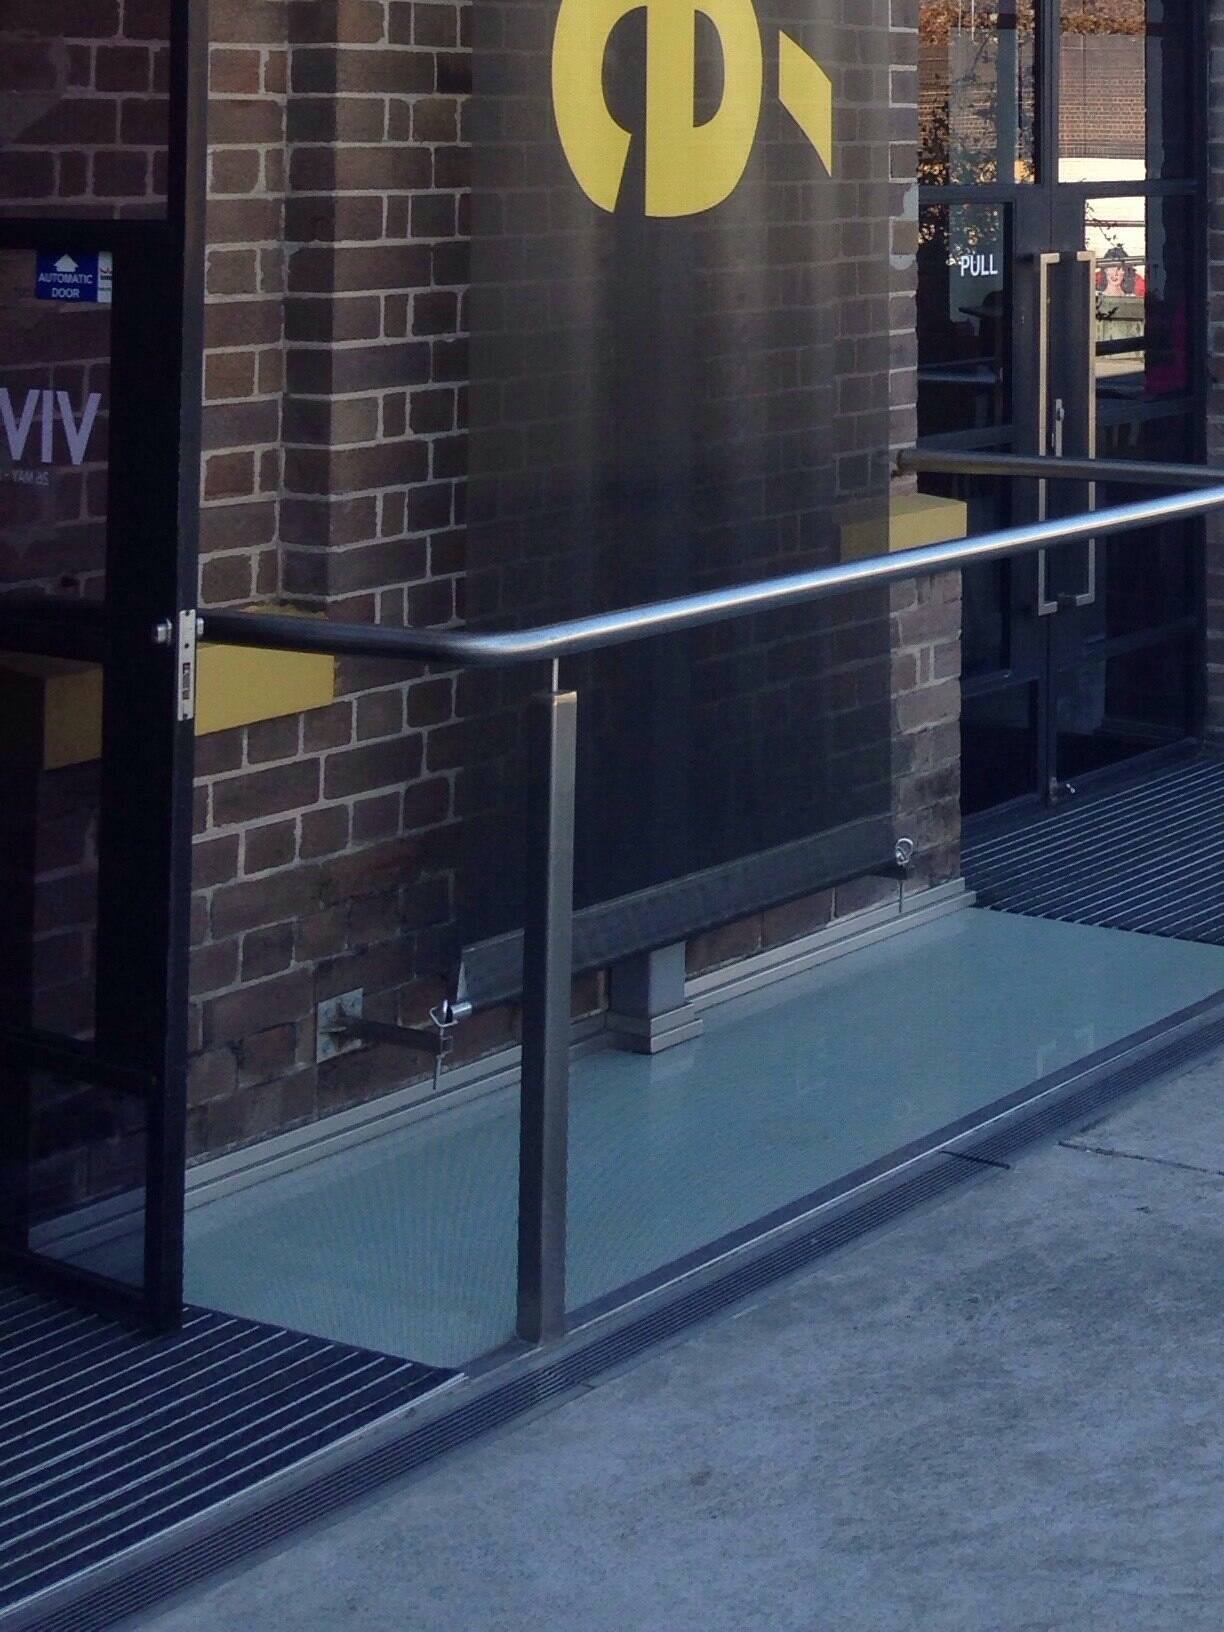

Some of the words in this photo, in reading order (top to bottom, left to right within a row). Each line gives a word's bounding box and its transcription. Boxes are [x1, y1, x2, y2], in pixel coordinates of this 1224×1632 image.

[960, 254, 998, 277] PULL
[38, 272, 93, 284] AUTOMATIC
[52, 287, 80, 298] DOOR
